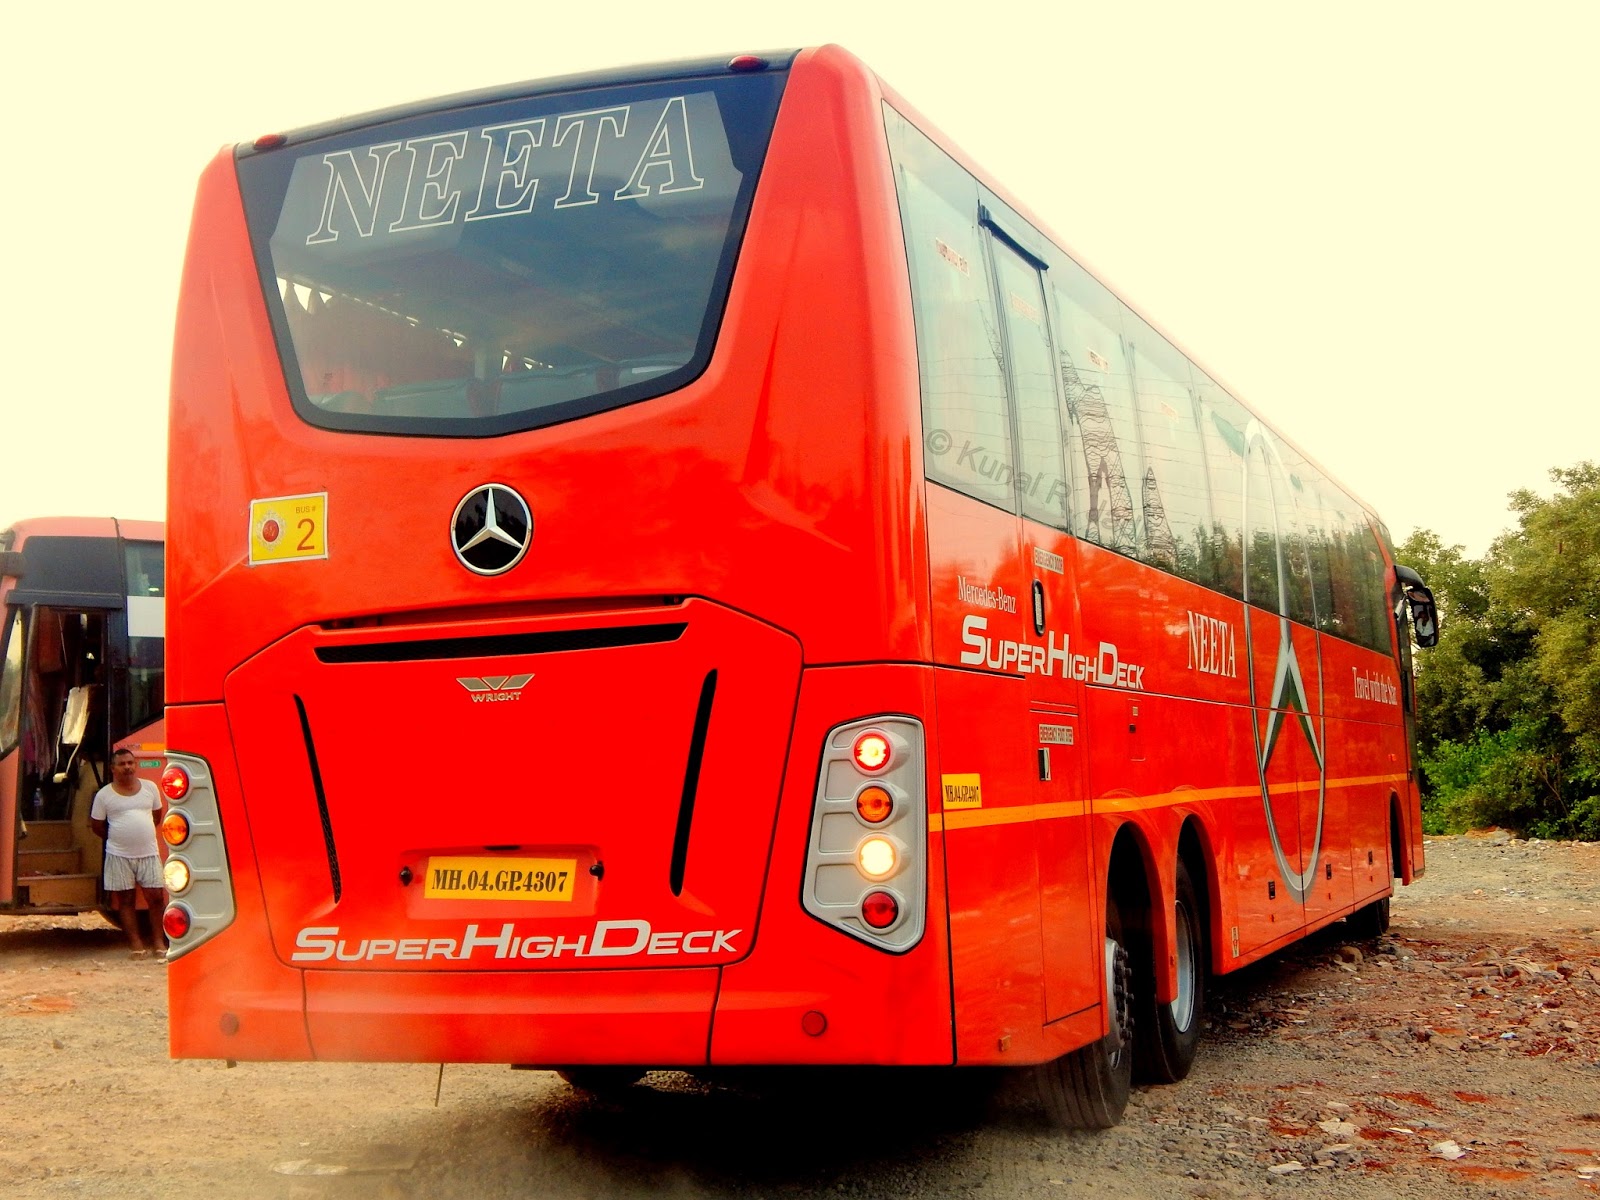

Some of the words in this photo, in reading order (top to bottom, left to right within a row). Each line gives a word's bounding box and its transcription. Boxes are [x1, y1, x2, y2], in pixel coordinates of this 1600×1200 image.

[306, 96, 704, 246] NEETA
[295, 505, 310, 514] BUS
[296, 518, 315, 551] 2
[957, 575, 1017, 614] Mercedes-Benz
[1187, 610, 1237, 678] NEETA
[470, 691, 521, 703] WRIGHT
[431, 868, 569, 893] MH.04.GP.4307
